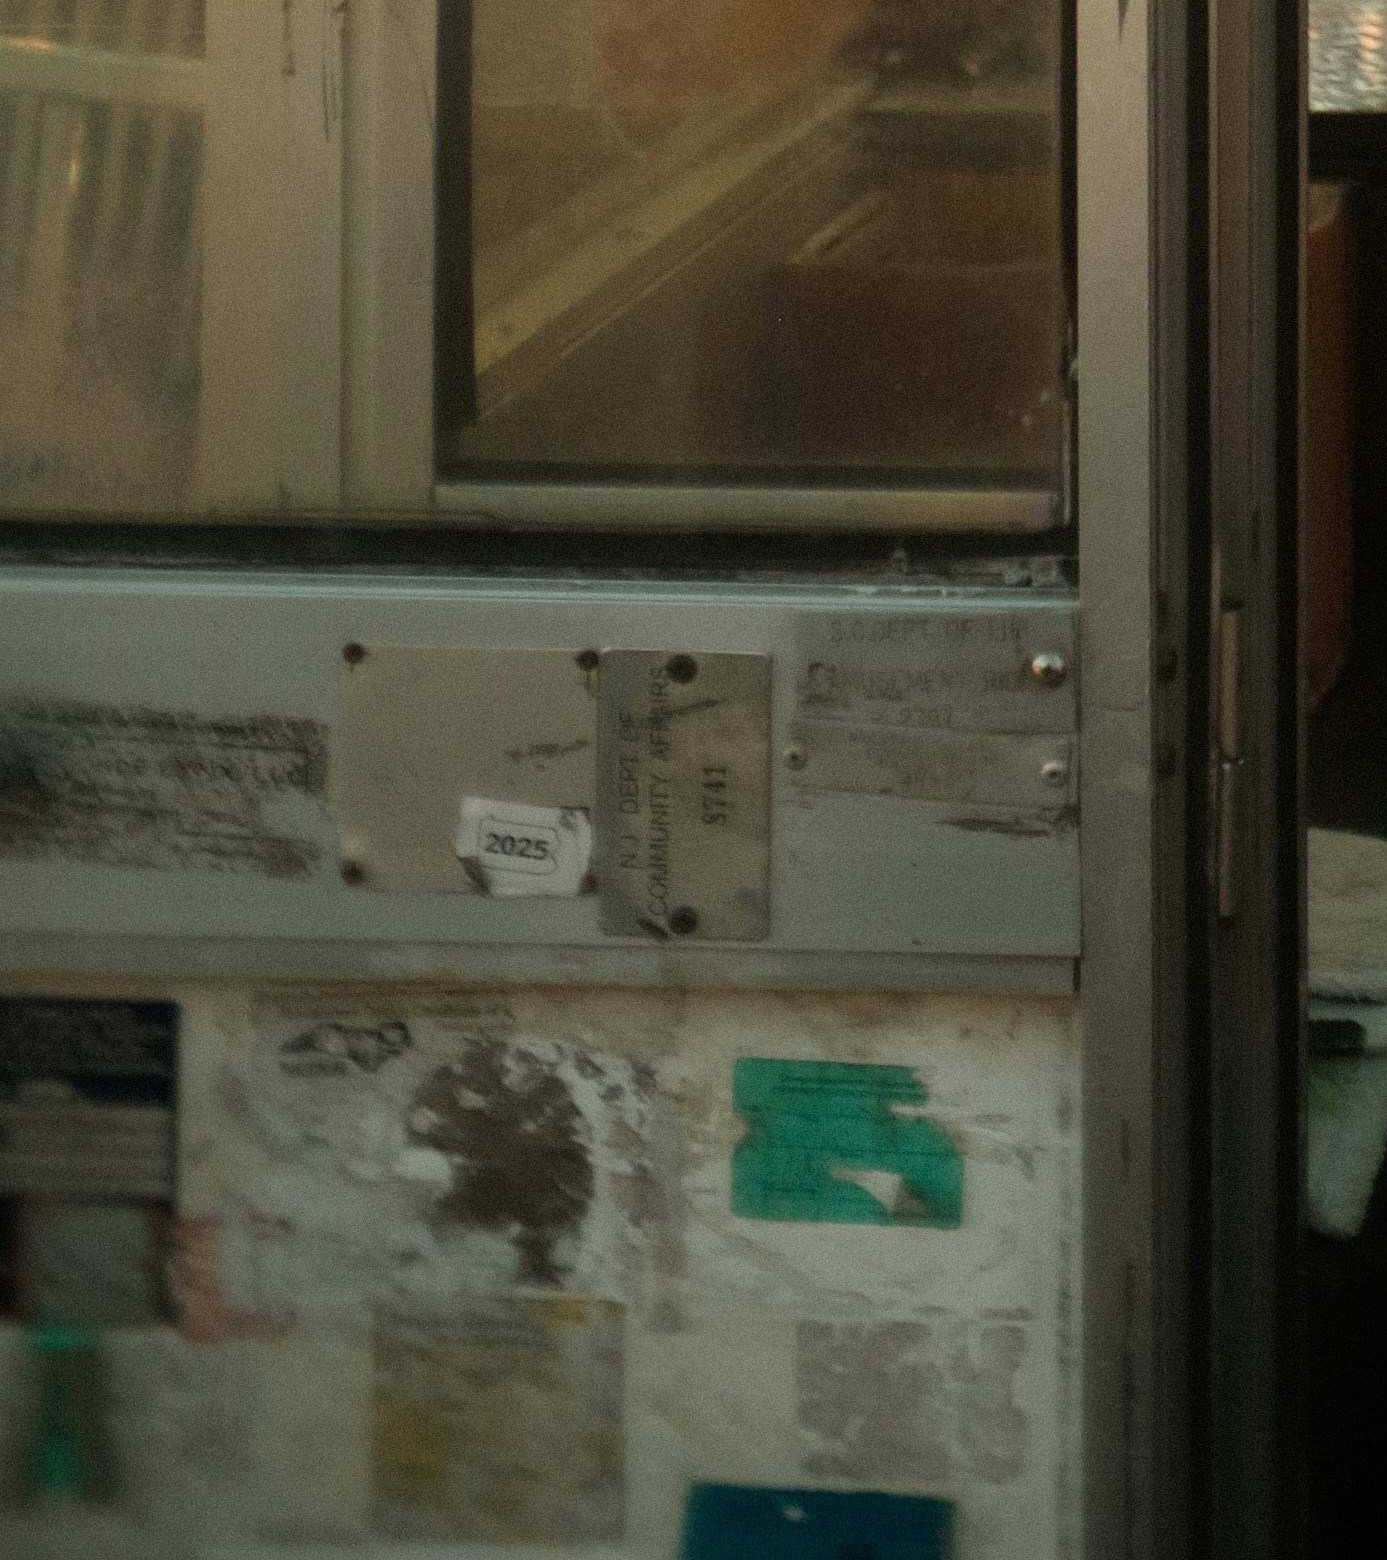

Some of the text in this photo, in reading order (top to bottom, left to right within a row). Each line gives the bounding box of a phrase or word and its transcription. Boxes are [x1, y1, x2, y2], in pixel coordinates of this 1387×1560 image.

[619, 711, 639, 742] OF
[619, 754, 639, 814] DEPT
[648, 666, 670, 916] COMMUNITY AFFAIRS
[485, 831, 550, 860] 2025
